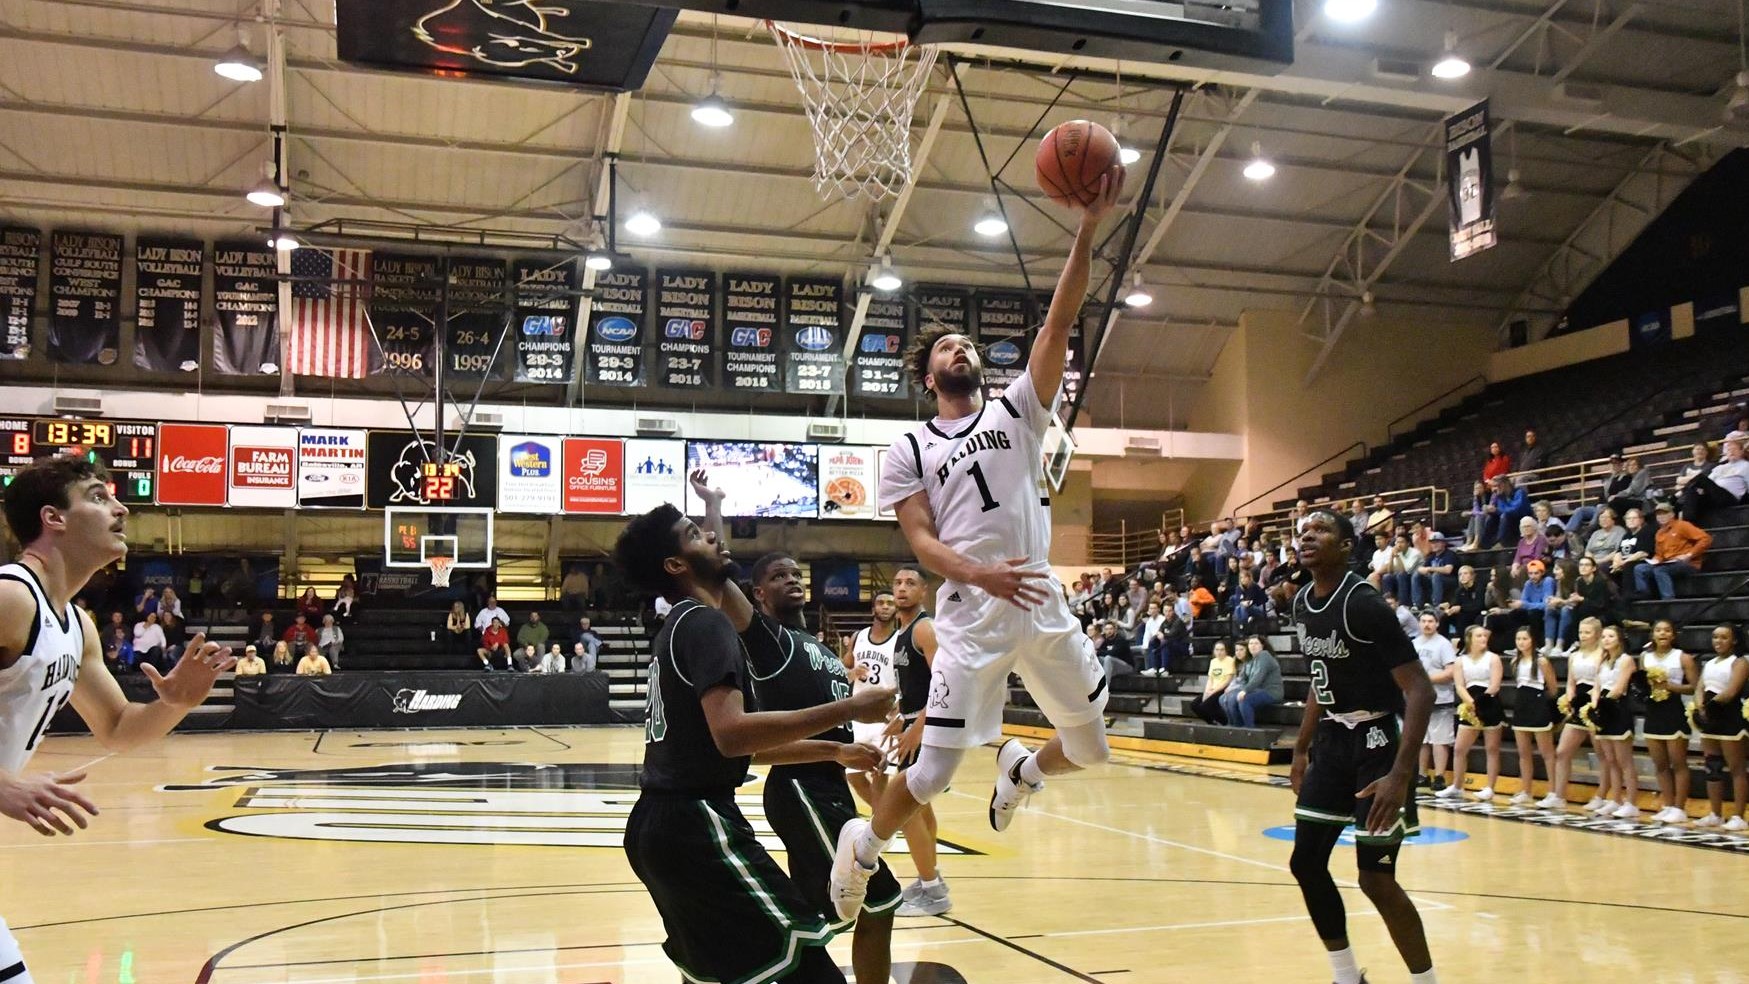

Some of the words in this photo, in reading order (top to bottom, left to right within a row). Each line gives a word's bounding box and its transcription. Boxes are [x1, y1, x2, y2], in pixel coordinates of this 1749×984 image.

[54, 247, 119, 260] VOLLEYBALL
[138, 246, 169, 261] LADY
[170, 248, 201, 262] BISON
[215, 251, 244, 264] LADY
[246, 252, 277, 265] BISON
[138, 262, 200, 275] VOLLEYBALL
[215, 265, 276, 277] VOLLEYBALL
[374, 260, 401, 273] LADY
[520, 268, 568, 283] LADY
[67, 277, 101, 288] WEST
[157, 278, 181, 288] GAC
[235, 282, 258, 291] GAC
[662, 275, 708, 290] LADY
[729, 280, 775, 294] LADY
[138, 288, 199, 299] CHAMPIONS
[791, 283, 837, 297] LADY
[661, 291, 710, 306] BISON
[727, 295, 776, 310] BISON
[216, 302, 276, 312] CHAMPIONS
[790, 299, 838, 312] BISON
[660, 307, 710, 319] BASKETBALL
[727, 310, 777, 323] BASKETBALL
[980, 311, 1024, 324] BISON
[522, 315, 566, 336] GAC
[602, 327, 635, 336] NCAA
[664, 318, 706, 340] GAC
[386, 325, 420, 340] 24-5
[456, 330, 489, 345] 26-4
[731, 327, 772, 347] GAC
[518, 342, 571, 352] CHAMPIONS
[591, 344, 641, 355] TOURNAMENT
[660, 343, 710, 354] CHAMPIONS
[860, 333, 900, 353] GAC
[382, 351, 423, 370] 1996
[453, 353, 492, 372] 1997
[526, 354, 563, 366] 29-3
[598, 356, 634, 369] 29-3
[668, 357, 702, 370] 23-7
[727, 352, 776, 363] TOURNAMENT
[790, 352, 839, 362] TOURNAMENT
[857, 356, 904, 368] CHAMPIONS
[527, 368, 563, 379] 2014
[726, 362, 777, 374] CHAMPIONS
[797, 364, 832, 378] 23-7
[599, 370, 633, 382] 2014
[668, 373, 702, 385] 2015
[862, 369, 899, 381] 31-4
[735, 376, 769, 388] 2015
[861, 382, 899, 393] 2017
[0, 421, 28, 431] HOME
[116, 424, 155, 436] VISITOR
[48, 423, 110, 445] 13:39
[302, 435, 349, 445] MARK
[13, 433, 30, 454] 8
[131, 437, 152, 458] 11
[252, 450, 289, 462] FARM
[301, 447, 364, 458] MARTIN
[8, 456, 33, 464] BONUS
[113, 459, 137, 467] BONUS
[237, 462, 289, 475] BUREAU
[424, 463, 460, 476] 13:39
[138, 478, 150, 496] 0
[246, 476, 289, 485] INSURANCE
[569, 476, 616, 486] COUSINS
[966, 460, 1000, 513] 1
[426, 477, 453, 499] 22
[823, 585, 849, 596] NCAA
[856, 650, 889, 666] HARDING
[1310, 659, 1335, 704] 2
[408, 689, 463, 710] HARDING
